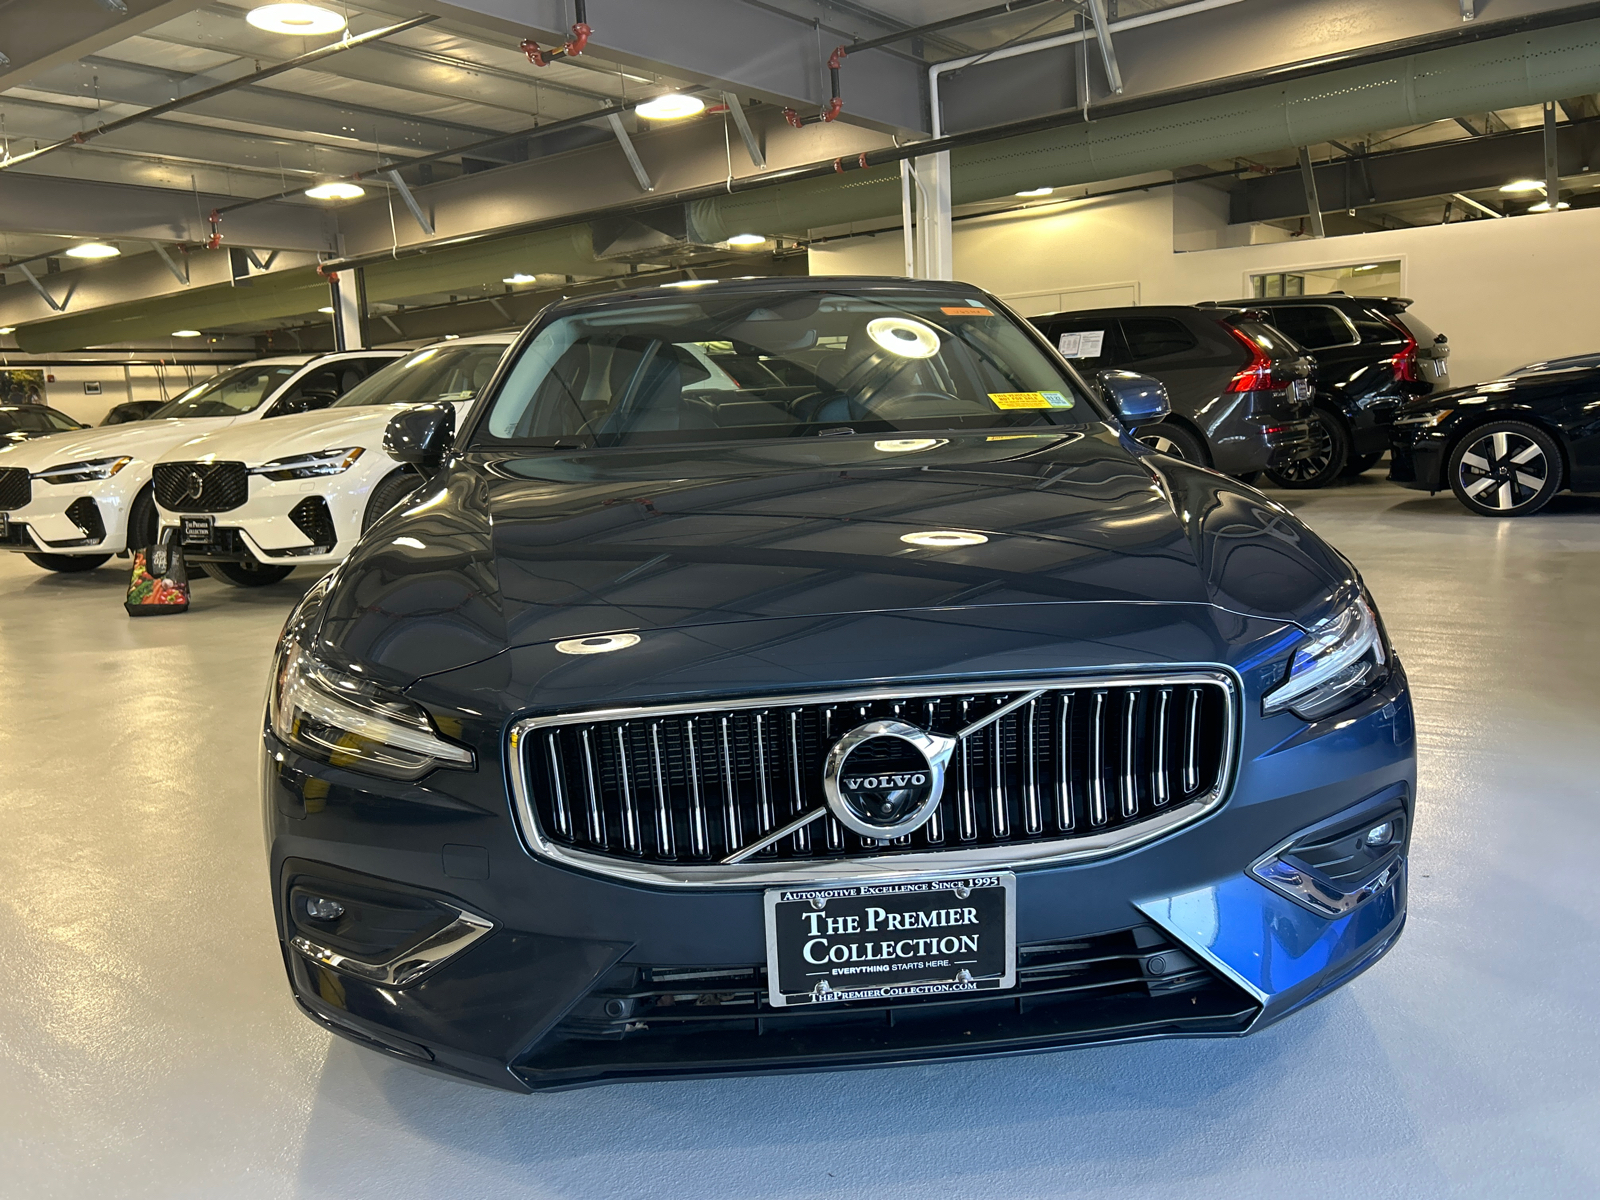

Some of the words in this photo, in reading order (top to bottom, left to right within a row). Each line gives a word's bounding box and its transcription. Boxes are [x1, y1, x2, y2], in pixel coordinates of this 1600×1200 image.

[843, 774, 926, 790] VOLVO
[783, 887, 857, 901] AUTOMOTIVE
[860, 882, 929, 895] EXCELLENCE
[931, 879, 965, 890] SINCE
[968, 876, 998, 888] 1995
[801, 910, 861, 937] THE
[865, 907, 979, 933] PREMIER
[803, 935, 979, 964] COLLECTION
[831, 964, 890, 976] EVERYTHING
[891, 961, 924, 972] STARTS
[925, 959, 952, 968] HERE.
[809, 981, 978, 1003] THEPREMIERCOLLECTION.COM
